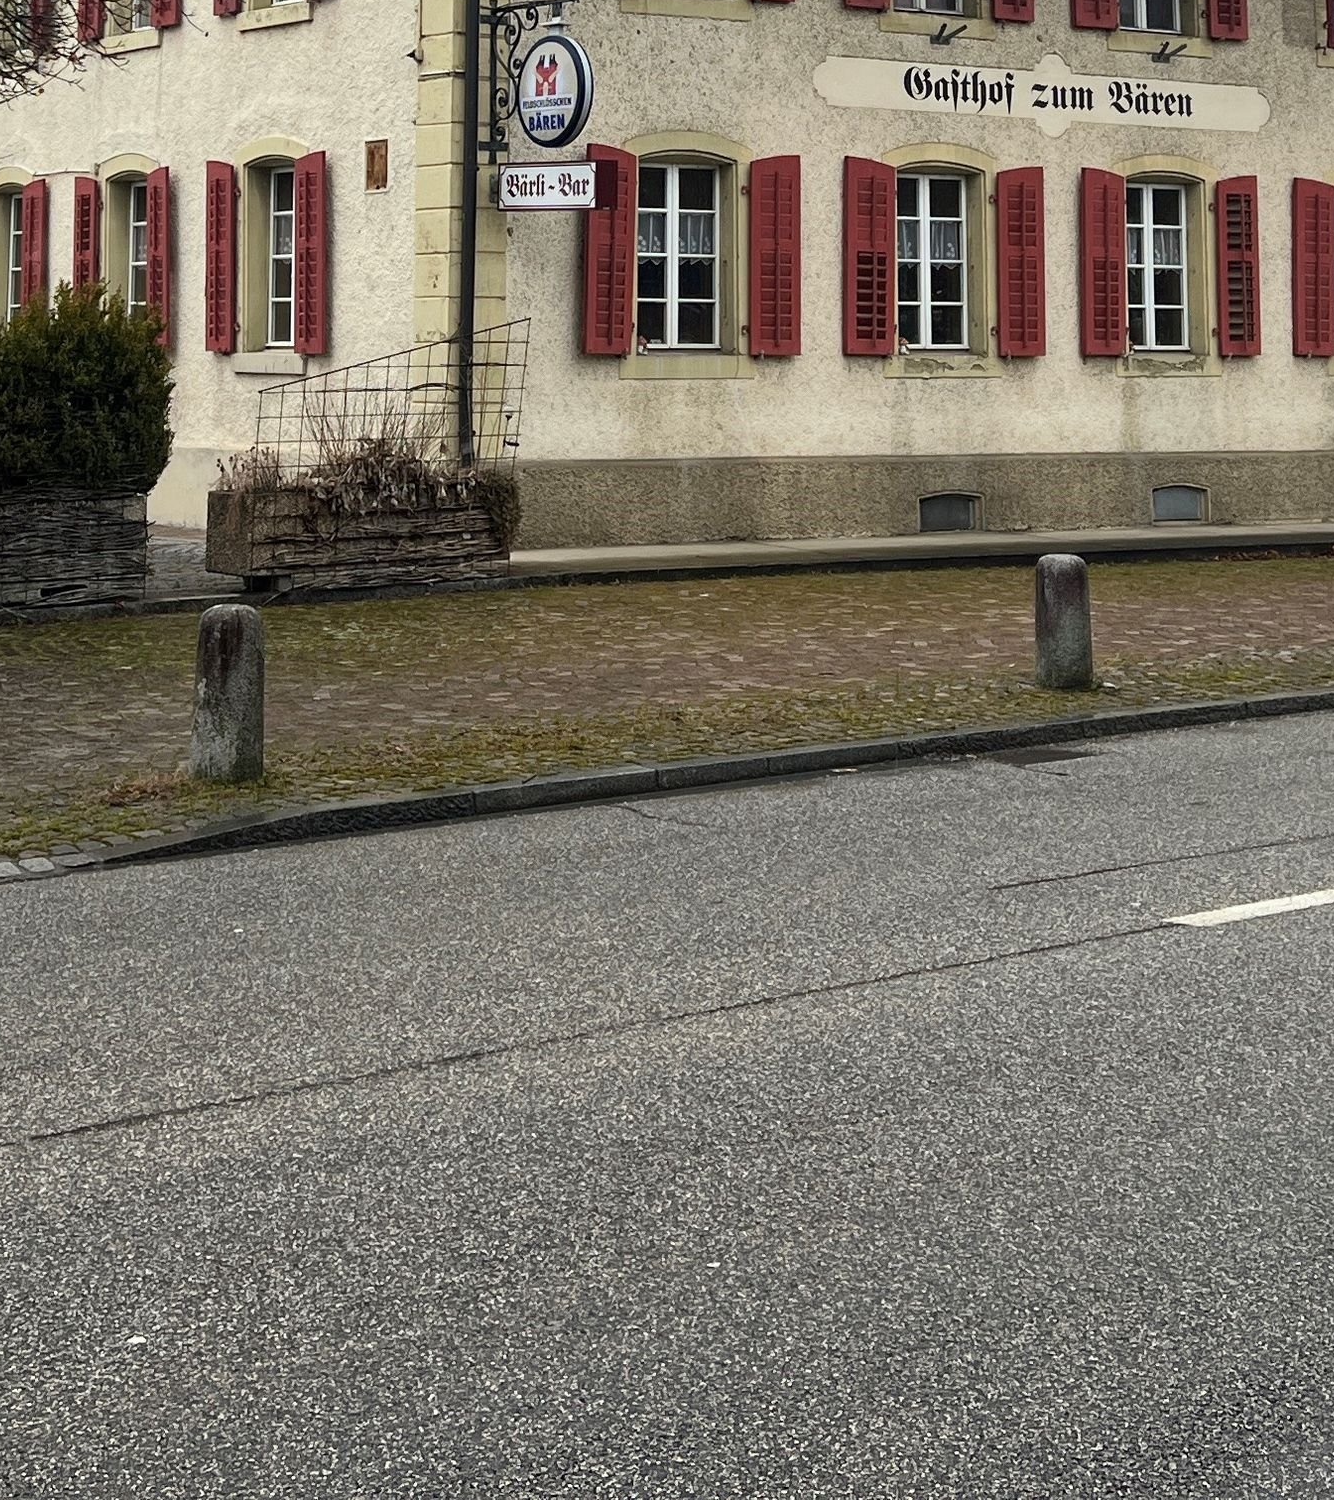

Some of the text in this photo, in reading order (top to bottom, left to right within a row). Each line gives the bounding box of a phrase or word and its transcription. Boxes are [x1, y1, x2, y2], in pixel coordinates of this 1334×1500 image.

[904, 66, 1193, 117] Gasthof zum Bären
[529, 111, 565, 131] BÄREN
